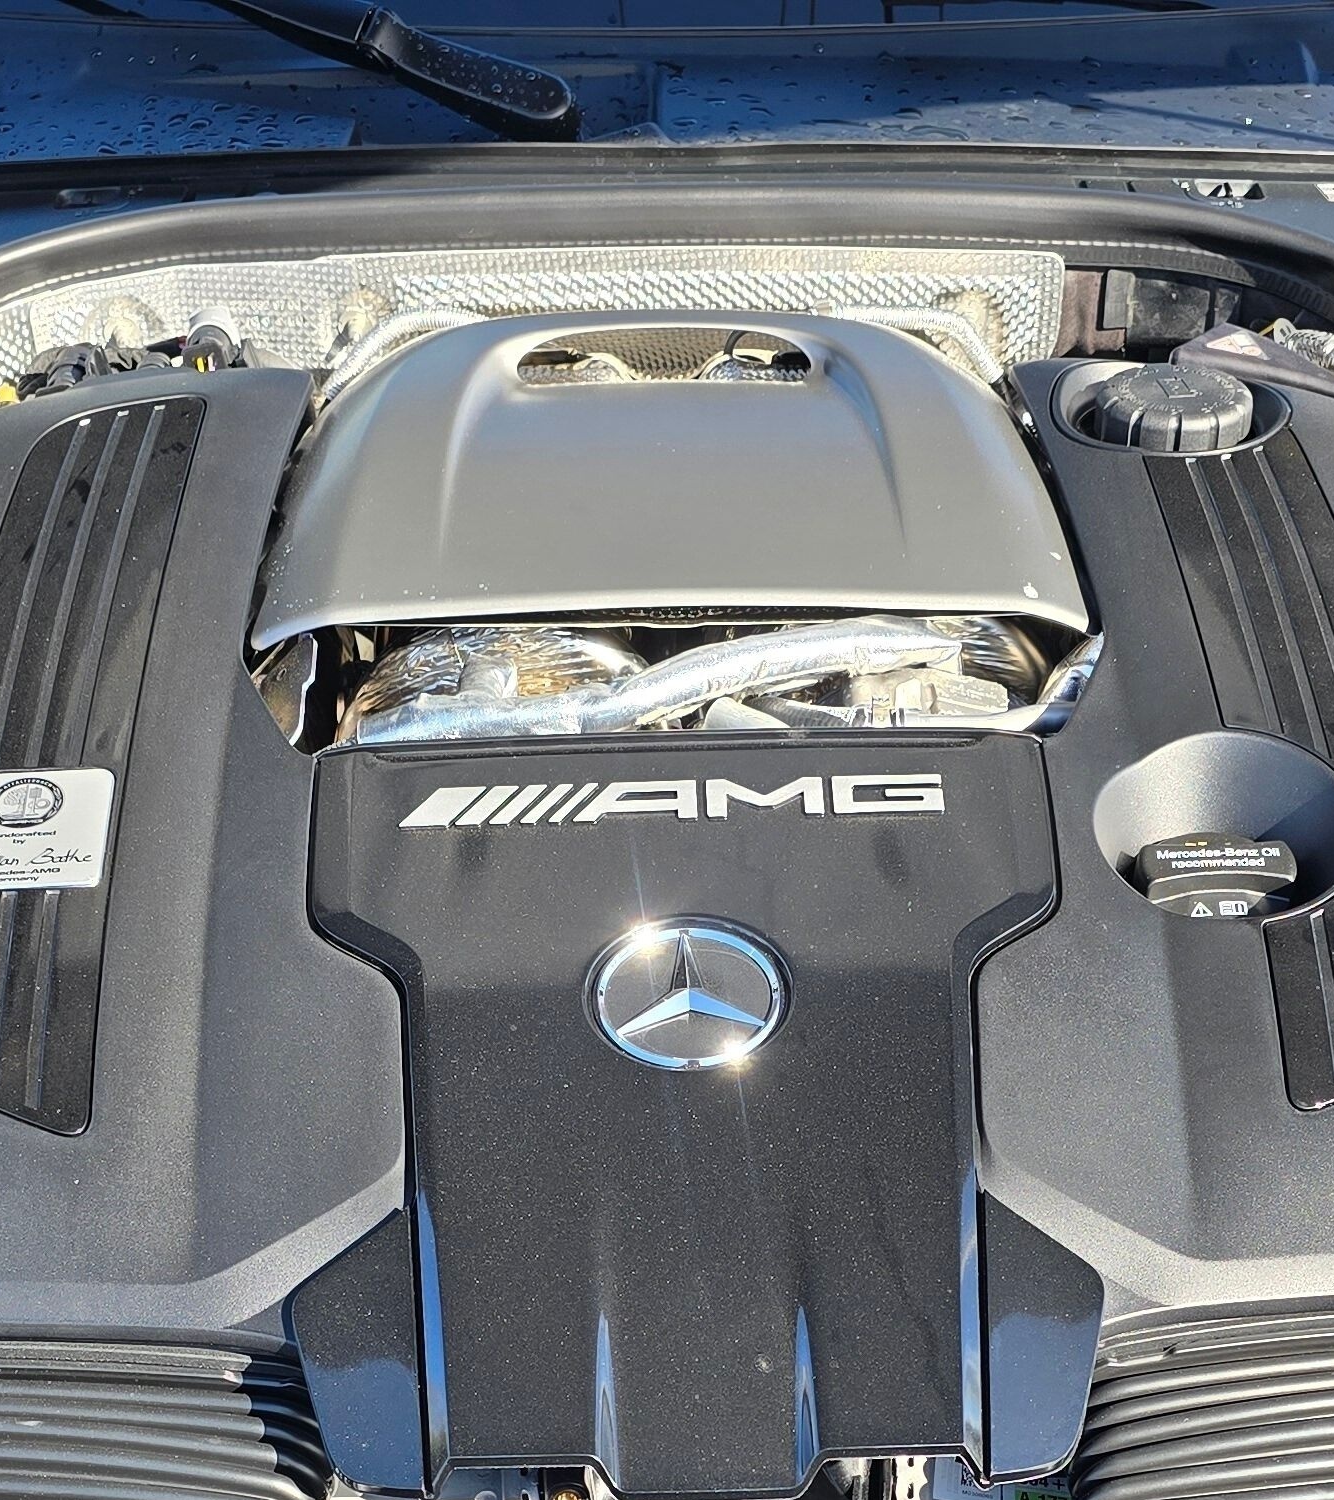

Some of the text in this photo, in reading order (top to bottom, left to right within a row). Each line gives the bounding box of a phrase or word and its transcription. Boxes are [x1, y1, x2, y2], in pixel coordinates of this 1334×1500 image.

[572, 773, 945, 825] AMG
[1156, 847, 1281, 860] Mercedes-Benz Oil
[1171, 857, 1266, 869] recommended
